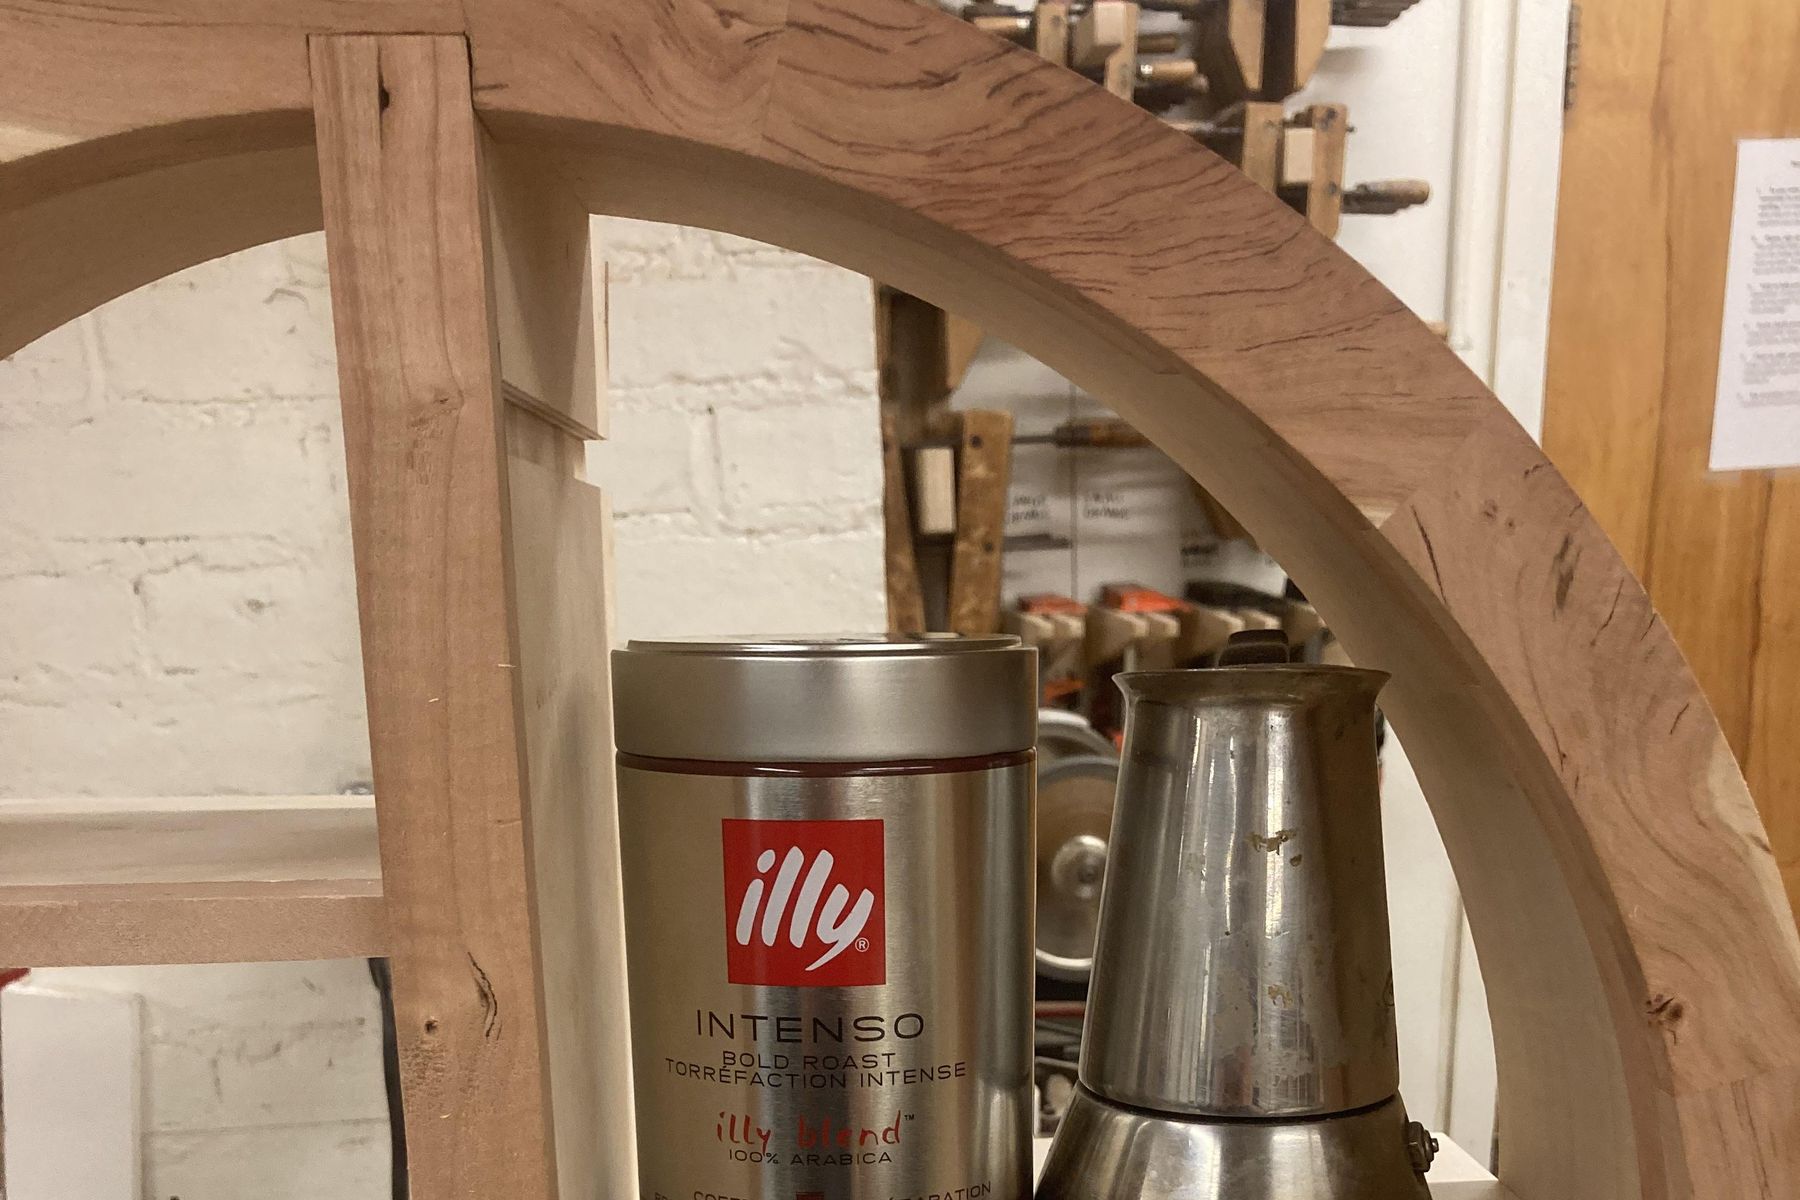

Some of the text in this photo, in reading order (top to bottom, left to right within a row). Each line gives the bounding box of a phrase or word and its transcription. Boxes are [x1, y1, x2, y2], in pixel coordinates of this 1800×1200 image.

[736, 845, 875, 971] illy
[696, 1009, 924, 1043] INTENSO
[665, 1057, 967, 1089] TORRÉFACTION INTENSE
[722, 1050, 896, 1070] BOLD ROAST
[716, 1110, 772, 1156] illy
[729, 1149, 893, 1167] 100% ARABICA
